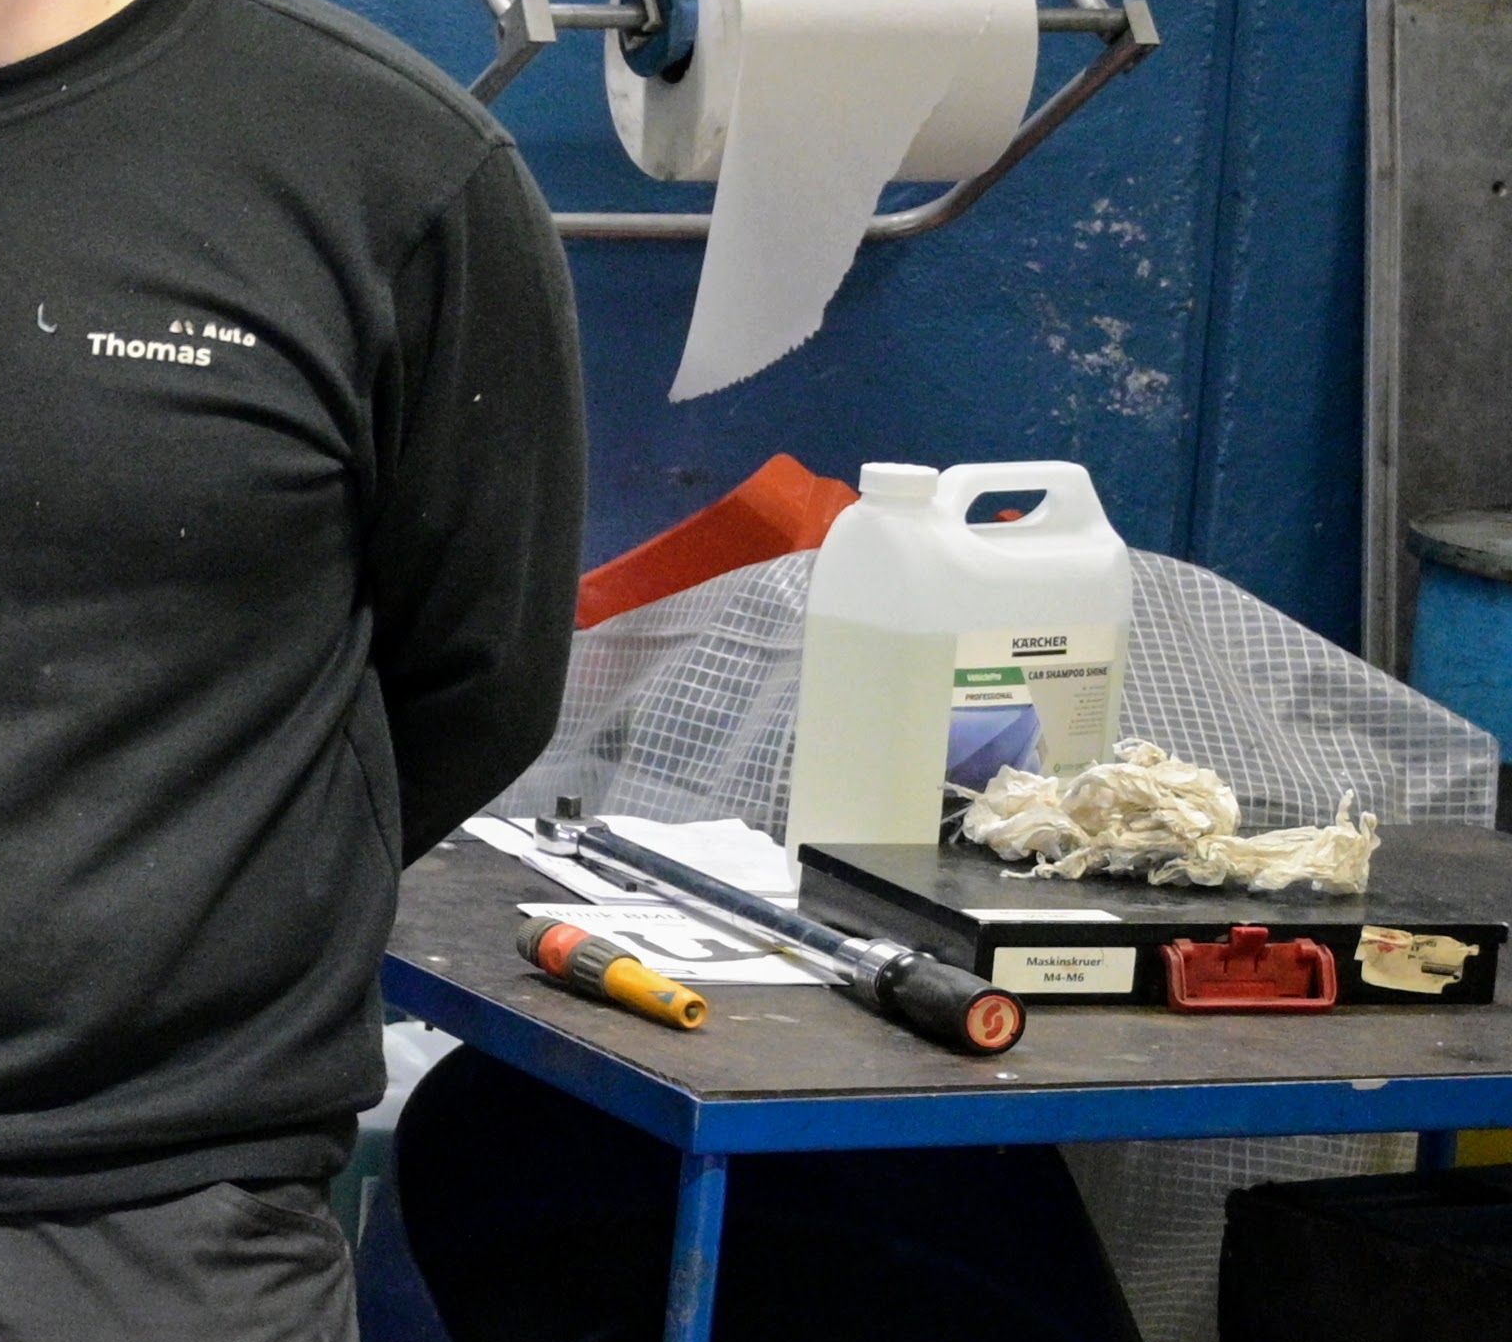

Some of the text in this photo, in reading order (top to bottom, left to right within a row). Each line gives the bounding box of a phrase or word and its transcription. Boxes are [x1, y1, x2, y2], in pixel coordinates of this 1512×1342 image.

[202, 322, 257, 347] Auto
[87, 332, 211, 367] Thomas
[1012, 636, 1067, 649] KÄRCHER
[1028, 666, 1108, 681] CAR SHAMPOO SHINE
[965, 692, 1013, 701] PROFESSIONAL
[1026, 957, 1102, 967] Maskinskruer
[1043, 972, 1085, 982] M4-M6
